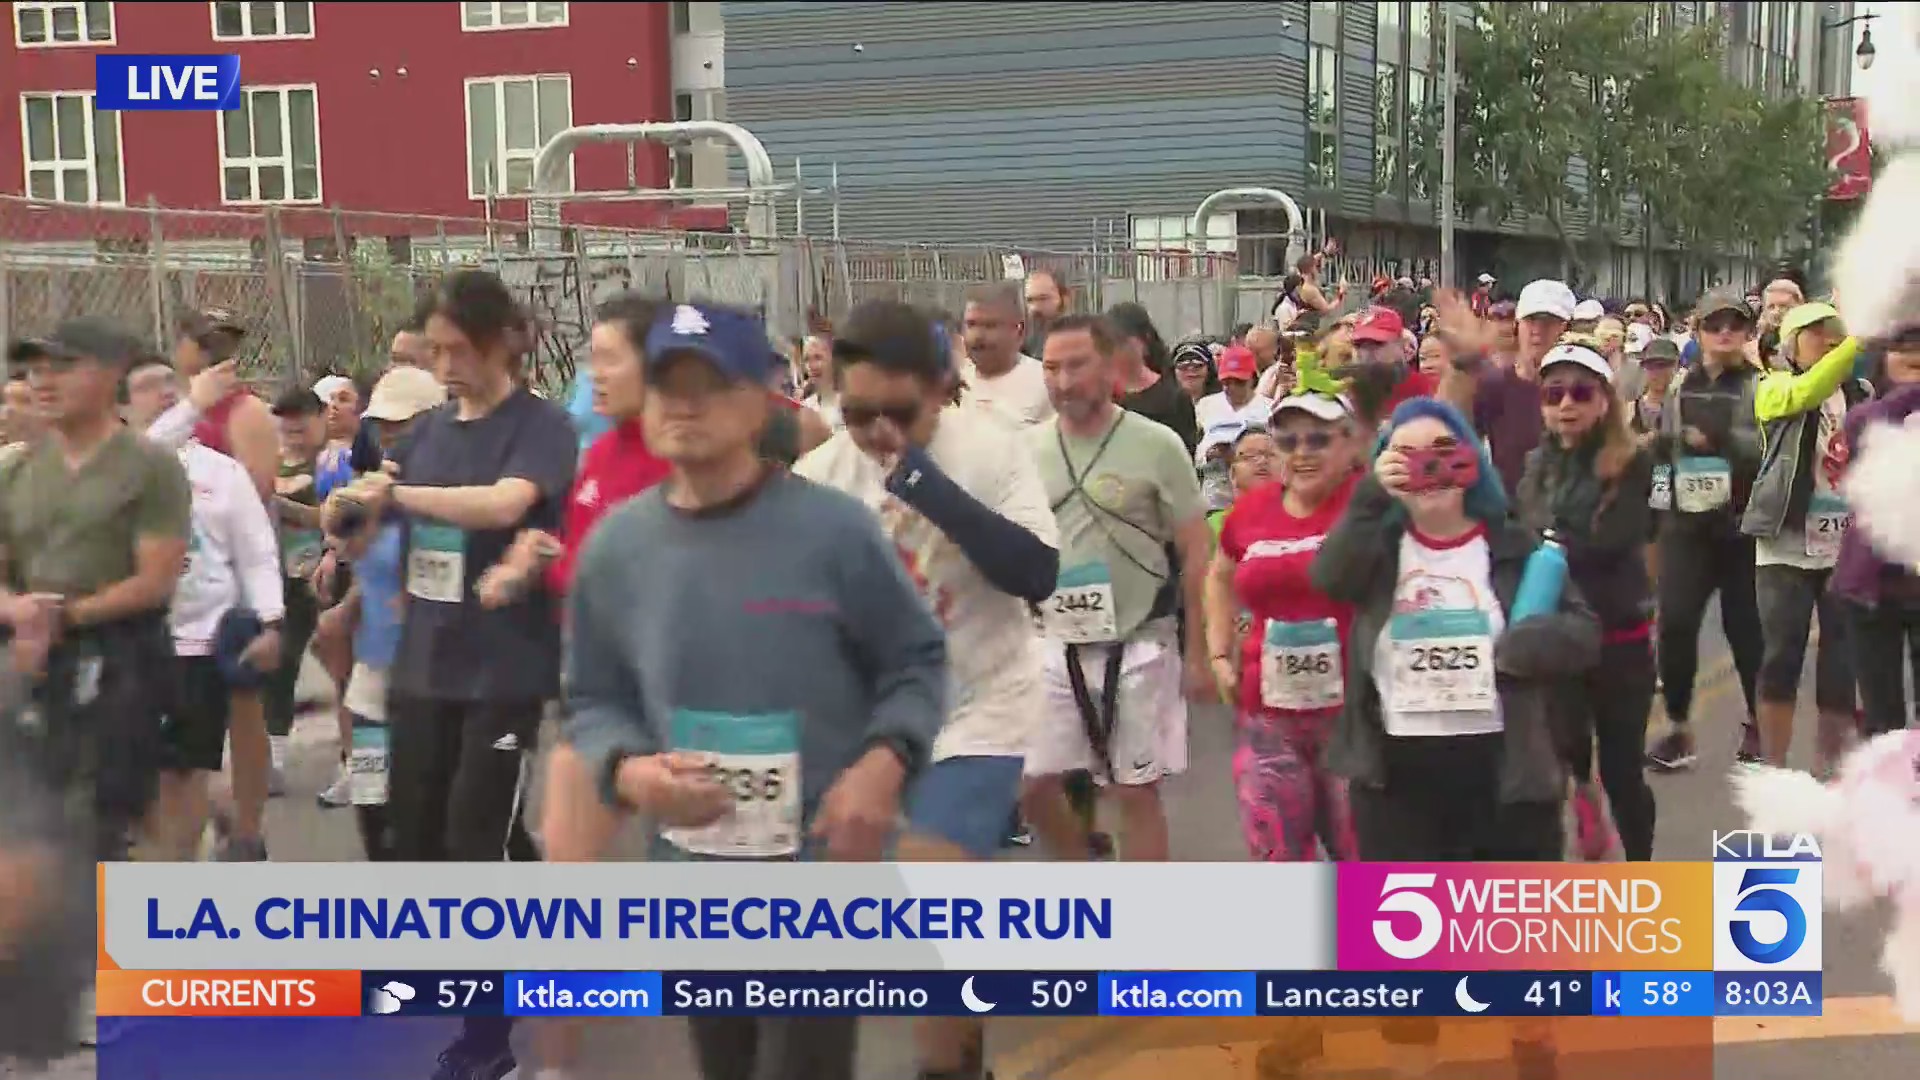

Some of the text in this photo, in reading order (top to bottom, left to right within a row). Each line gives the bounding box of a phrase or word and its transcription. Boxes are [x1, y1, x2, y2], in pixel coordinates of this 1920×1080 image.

[1819, 516, 1853, 532] 214
[1054, 592, 1104, 613] 2442
[1275, 652, 1332, 675] 1846
[1410, 646, 1480, 671] 2625
